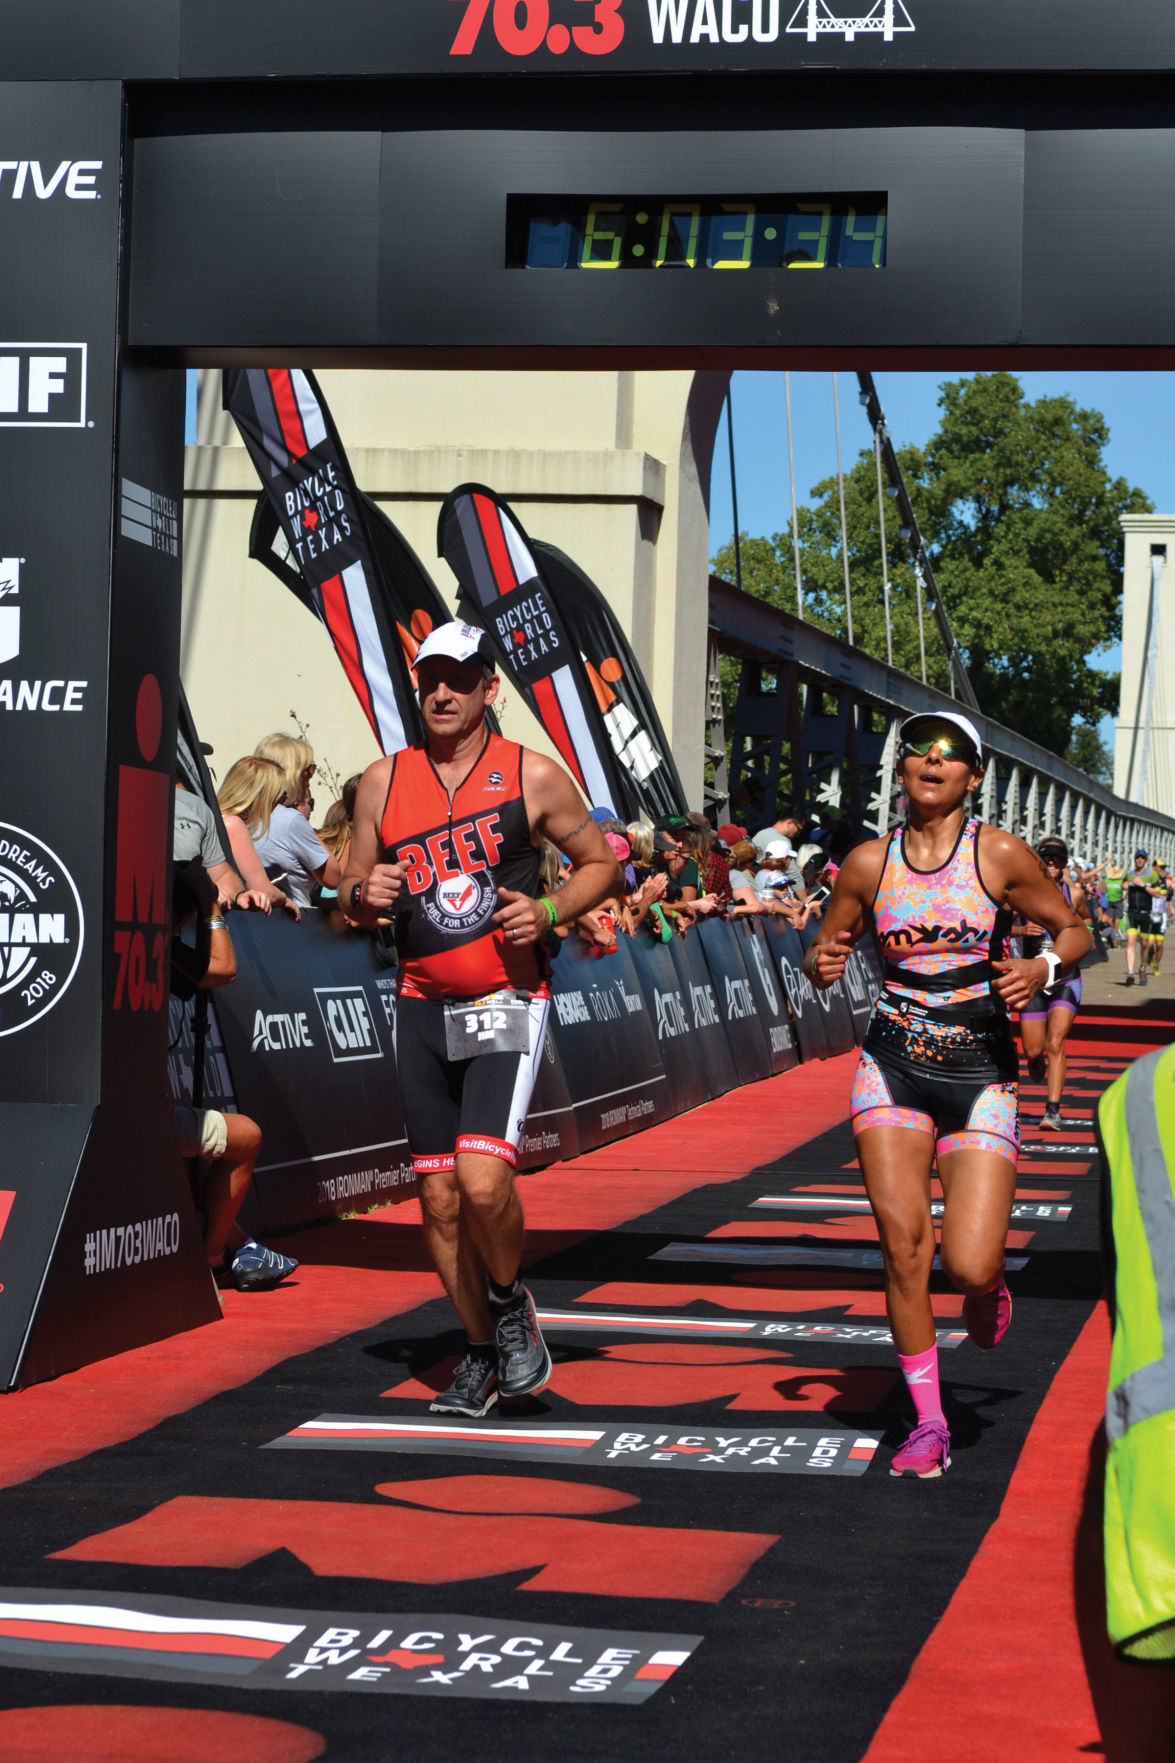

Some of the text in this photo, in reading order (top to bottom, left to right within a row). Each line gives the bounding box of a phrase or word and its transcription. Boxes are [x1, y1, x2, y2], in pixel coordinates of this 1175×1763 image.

[648, 0, 780, 44] WACO
[285, 461, 338, 517] BICYCLE
[295, 517, 352, 565] TEXAS
[495, 592, 547, 637] BICYCLE
[508, 631, 560, 671] TEXAS
[0, 839, 55, 890] DREAMS
[397, 812, 504, 896] BEEF
[0, 913, 65, 944] AN
[426, 886, 493, 928] FUEL FOR THE FINISH
[21, 970, 57, 1007] 2018
[113, 930, 164, 1012] 70.3
[326, 998, 373, 1050] CLIF
[464, 1010, 507, 1034] 312
[653, 987, 690, 1041] ACTIVE
[688, 981, 721, 1029] ACTIVE
[251, 1009, 315, 1053] ACTIVE
[374, 1164, 400, 1191] Premier
[84, 1212, 180, 1276] #IM703WACO
[605, 1449, 834, 1468] TEXAS
[614, 1432, 845, 1448] BICYCLE
[312, 1627, 641, 1666] BICYCLE
[284, 1662, 613, 1693] TEXAS
